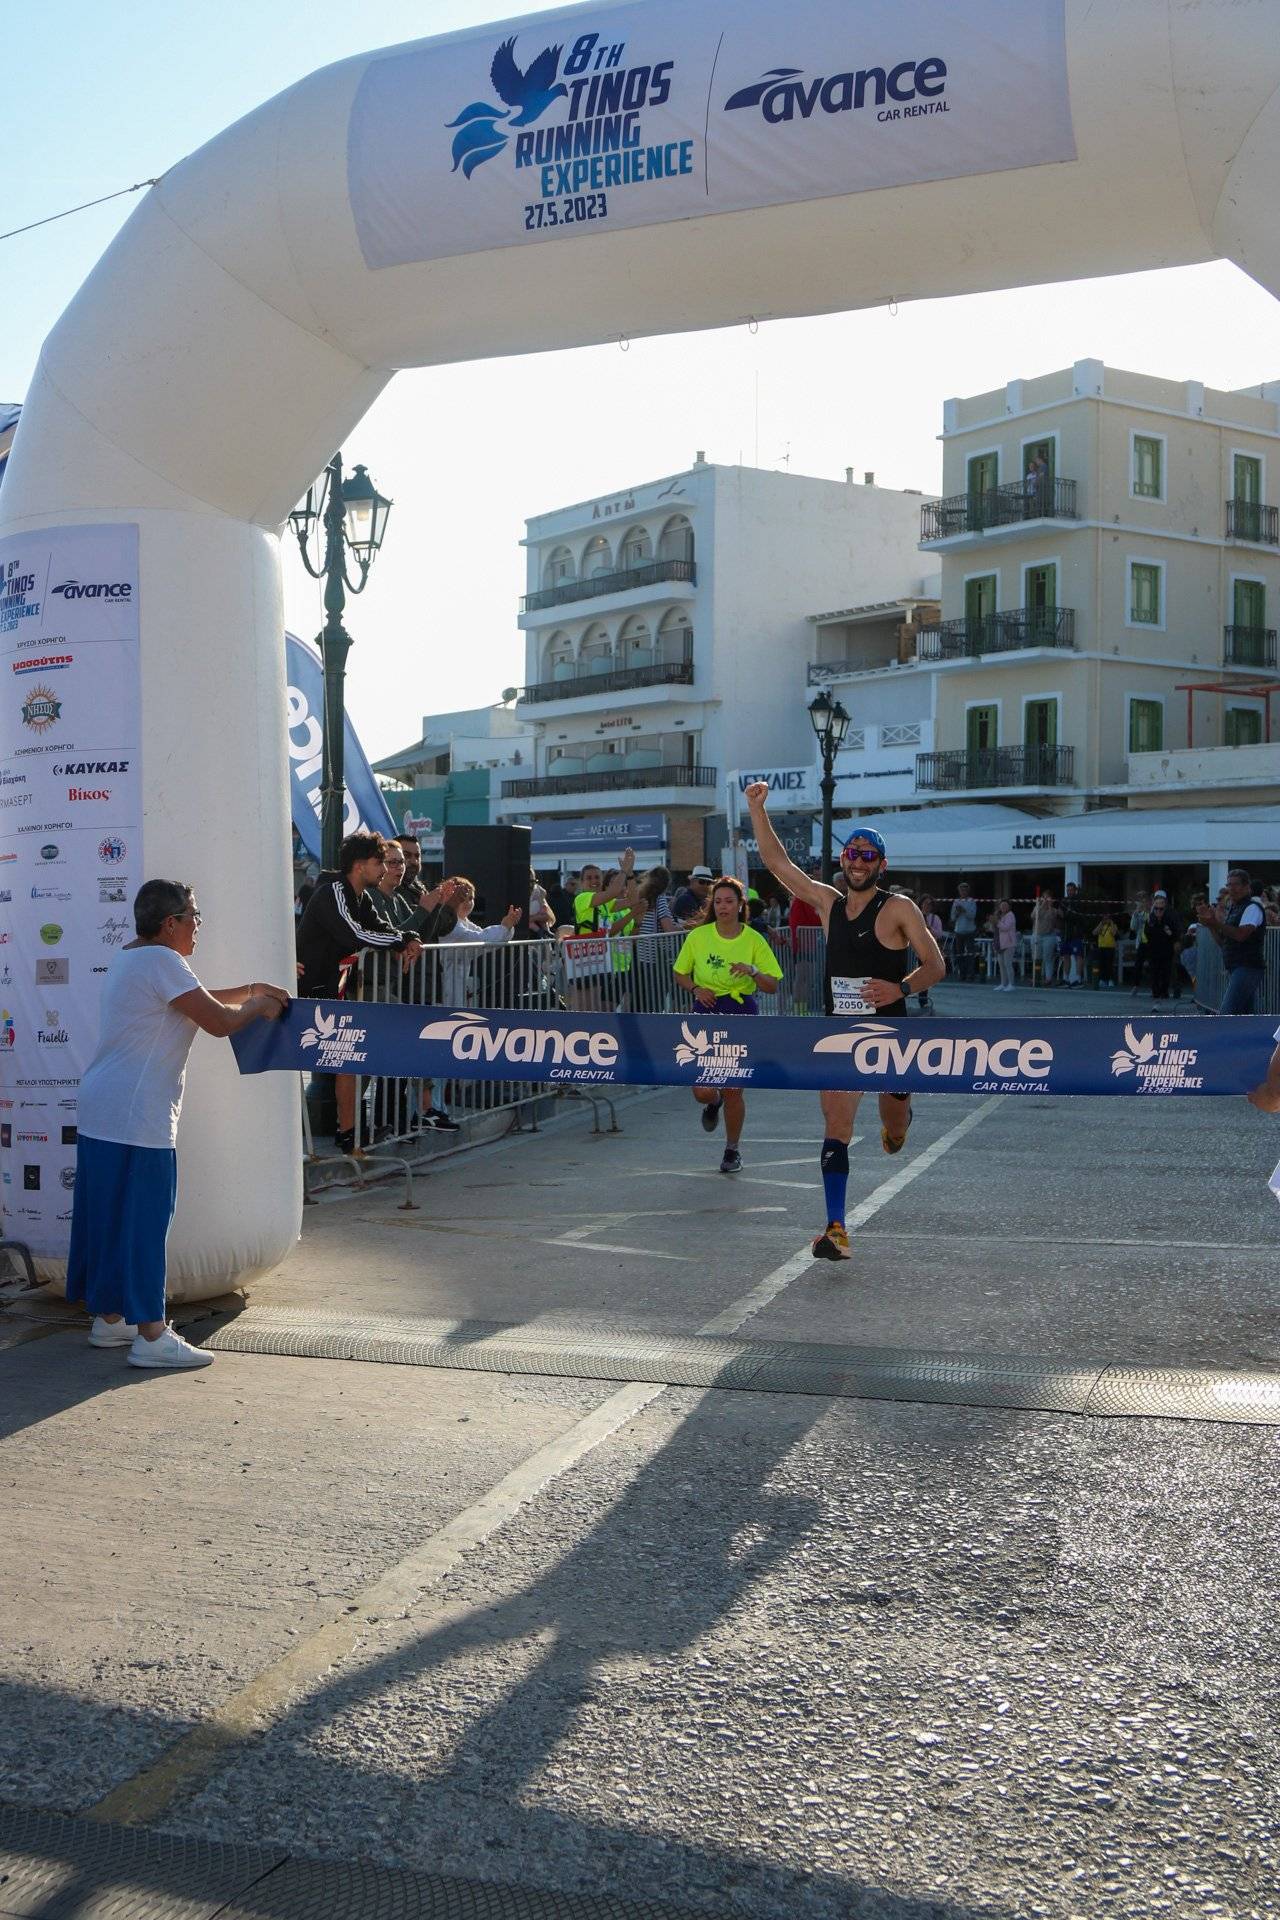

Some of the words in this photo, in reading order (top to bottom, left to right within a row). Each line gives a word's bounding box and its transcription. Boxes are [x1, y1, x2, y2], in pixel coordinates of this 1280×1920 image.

[563, 33, 625, 76] 8TH
[568, 60, 675, 122] TINOS
[762, 57, 947, 124] avance
[877, 110, 900, 122] CAR
[904, 101, 950, 119] RENTAL
[515, 111, 641, 169] RUNNING
[540, 140, 694, 198] EXPERIENCE
[525, 193, 608, 230] 27.5.2023
[8, 560, 20, 578] 8TH
[7, 574, 35, 595] TINOS
[63, 583, 132, 600] avance
[45, 743, 74, 753] ΧΟΡΗΓΟΙ
[44, 822, 73, 831] ΧΟΡΗΓΟΙ
[838, 1000, 863, 1009] 2050
[339, 1015, 353, 1028] 8TH
[336, 1029, 367, 1043] TINOS
[712, 1031, 728, 1044] 8TH
[1160, 1033, 1179, 1049] 8TH
[317, 1040, 356, 1052] RUNNING
[452, 1026, 619, 1067] avance
[712, 1044, 748, 1058] TINOS
[321, 1050, 368, 1062] EXPERIENCE
[697, 1055, 740, 1068] RUNNING
[854, 1037, 1054, 1078] avance
[1157, 1049, 1198, 1065] TINOS
[315, 1058, 344, 1069] 27.5.2023
[1135, 1064, 1185, 1077] RUNNING
[550, 1069, 572, 1080] CAR
[574, 1070, 616, 1081] RENTAL
[694, 1076, 728, 1084] 27.5.2023
[702, 1067, 755, 1079] EXPERIENCE
[972, 1081, 998, 1092] CAR
[1000, 1082, 1050, 1092] RENTAL
[1143, 1077, 1204, 1089] EXPERIENCE
